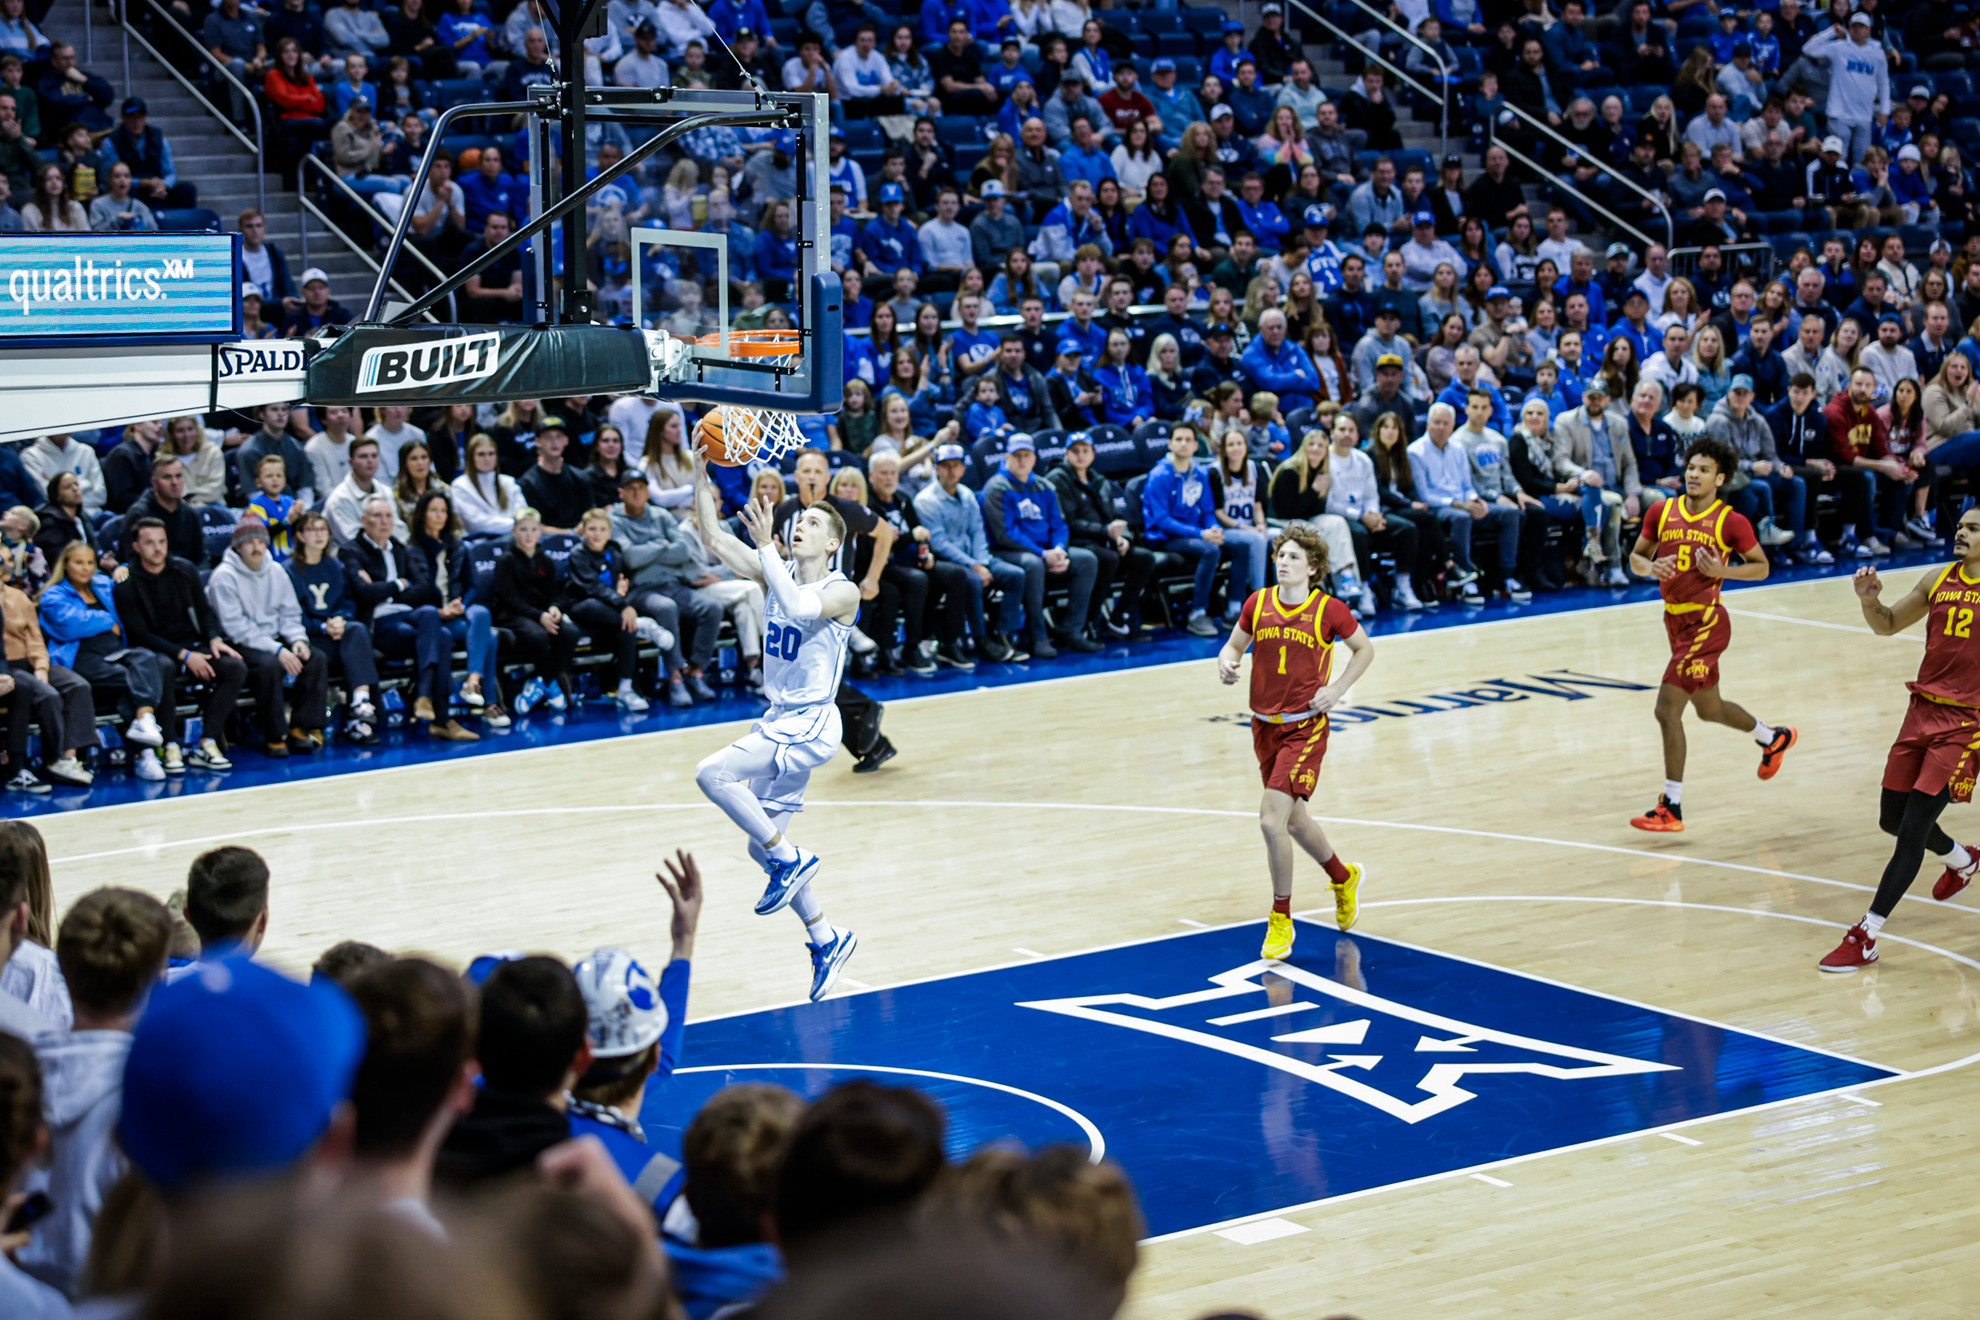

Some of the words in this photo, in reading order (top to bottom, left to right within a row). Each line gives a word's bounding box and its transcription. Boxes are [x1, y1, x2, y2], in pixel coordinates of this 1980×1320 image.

[219, 347, 309, 378] SPALDI
[376, 338, 497, 386] BUILT
[1661, 528, 1684, 543] IOWA
[1686, 528, 1716, 548] STATE
[1677, 544, 1692, 572] 5
[308, 582, 330, 610] Y
[1934, 590, 1962, 605] IOWA
[1256, 626, 1281, 642] IOWA
[1283, 627, 1316, 649] STATE
[1943, 606, 1974, 639] 12
[765, 620, 803, 662] 20
[1277, 645, 1288, 675] 1
[1329, 669, 1657, 732] Marrio
